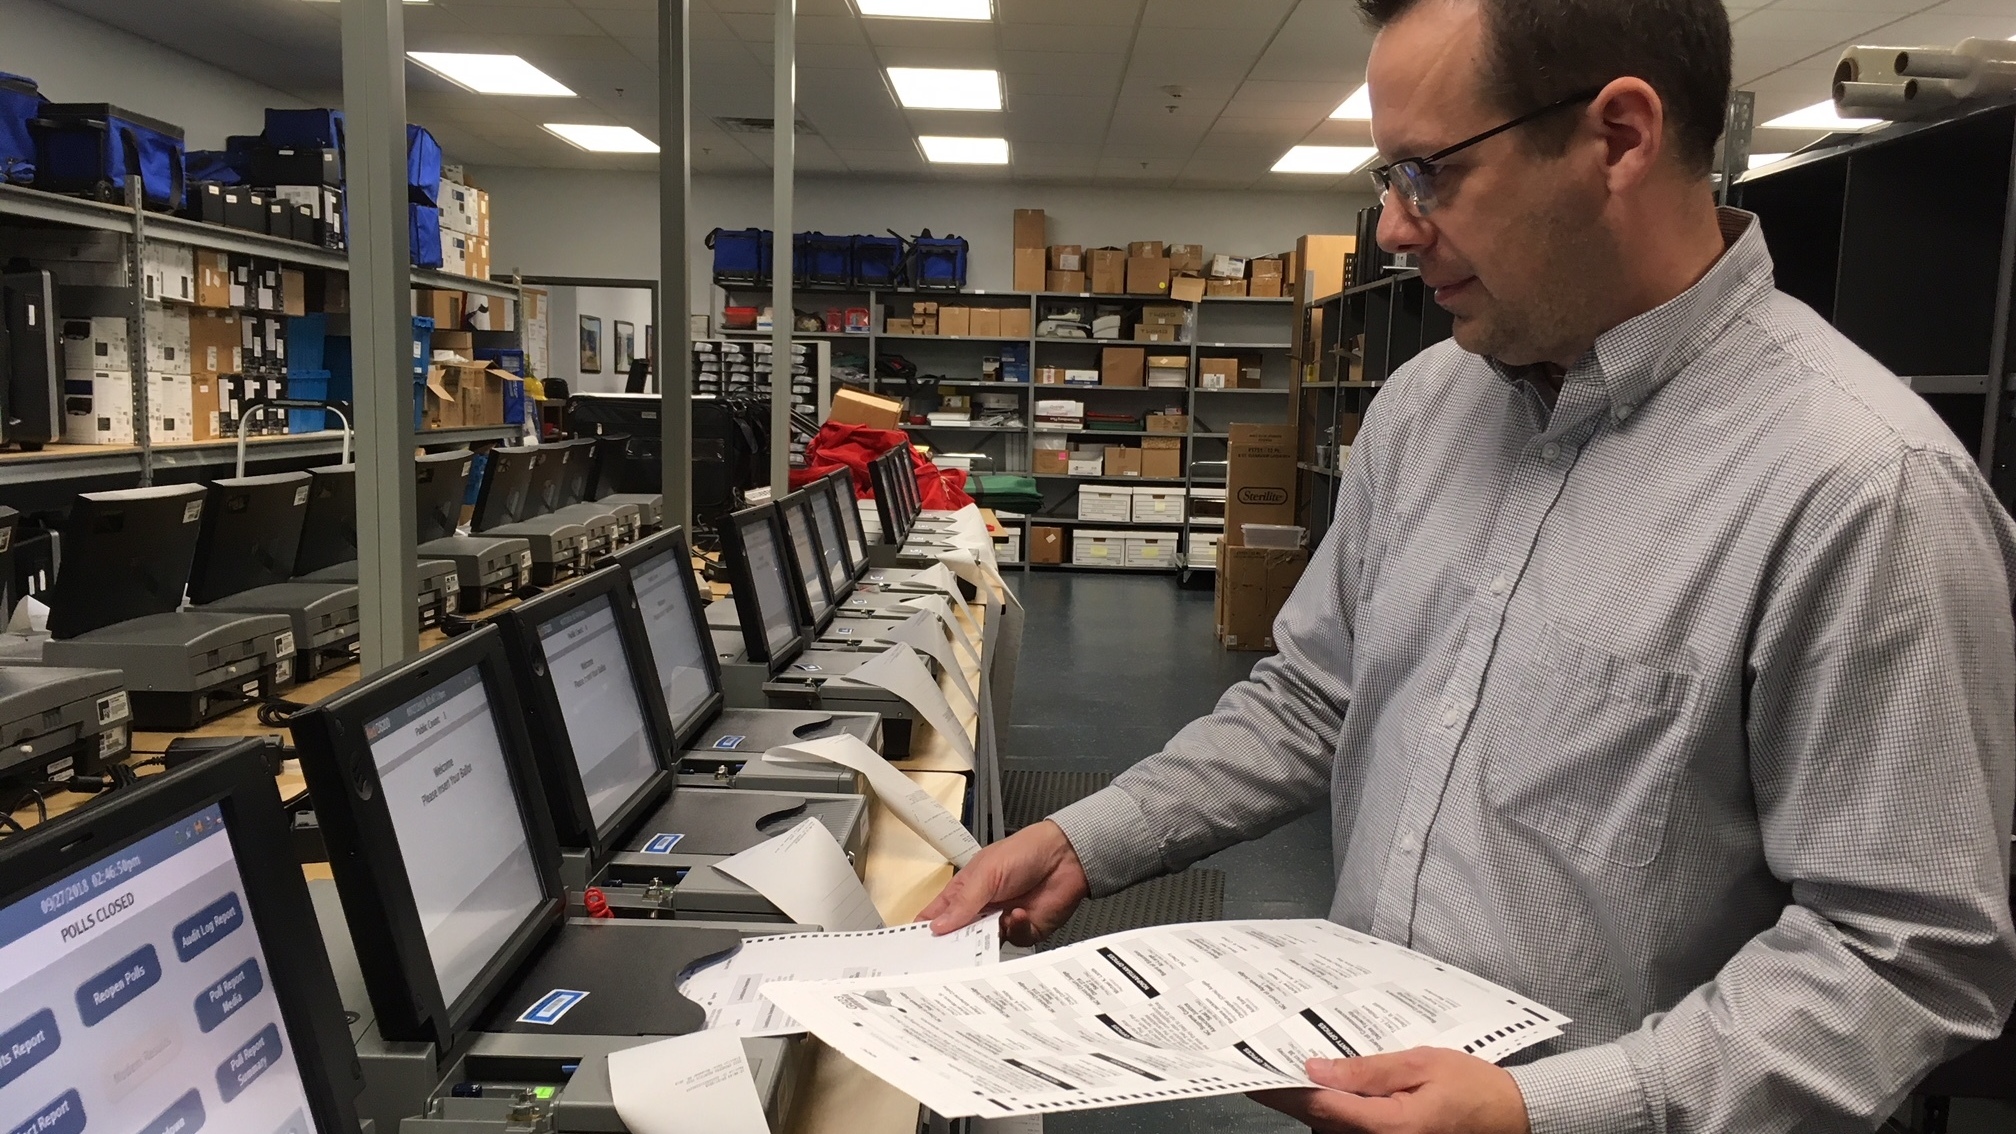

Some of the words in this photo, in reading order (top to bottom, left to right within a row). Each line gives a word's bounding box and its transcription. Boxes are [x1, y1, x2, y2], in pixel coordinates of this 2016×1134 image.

[1242, 490, 1282, 502] Sterilite
[433, 758, 454, 778] Welcome
[421, 789, 438, 807] Please
[40, 878, 90, 915] 09/27/2018
[91, 855, 142, 888] 02:46:50pm
[60, 913, 96, 943] POLLS
[96, 892, 135, 923] CLOSED
[182, 928, 201, 949] Audit
[200, 918, 215, 938] Log
[213, 906, 236, 930] Report
[1105, 953, 1125, 967] OFFICES
[92, 973, 125, 1007] Reopen
[124, 963, 146, 986] Polls
[208, 983, 223, 1003] Poll
[222, 970, 246, 994] Report
[1120, 965, 1151, 990] NONPARTISAN
[221, 992, 243, 1014] Media
[12, 1029, 45, 1059] Report
[1317, 1022, 1339, 1041] OFFICES
[229, 1053, 244, 1072] Poll
[243, 1036, 266, 1062] Report
[1243, 1047, 1264, 1064] OFFICES
[1338, 1039, 1357, 1059] COUNTY
[237, 1056, 268, 1087] Summary
[37, 1100, 70, 1131] Report
